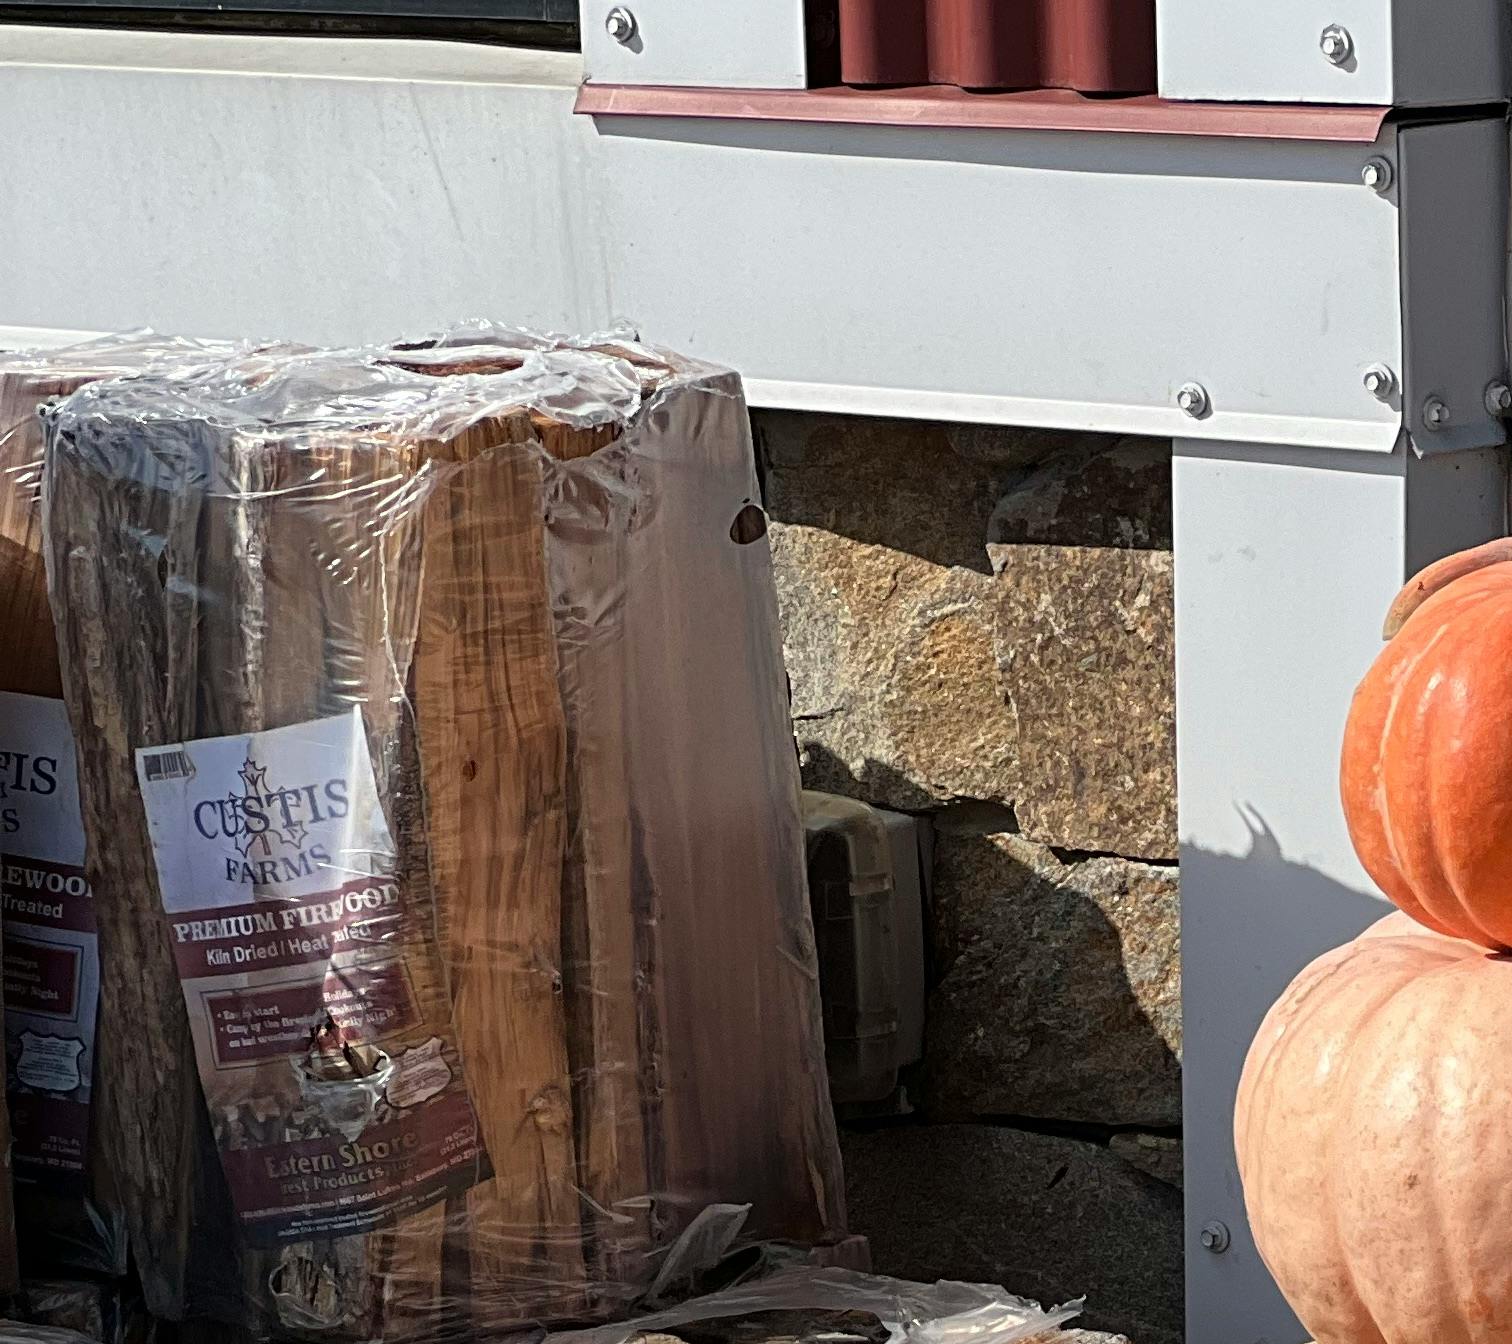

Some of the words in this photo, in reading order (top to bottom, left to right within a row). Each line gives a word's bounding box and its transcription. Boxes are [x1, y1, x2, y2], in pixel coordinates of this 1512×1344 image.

[193, 778, 350, 841] CUSTIS
[225, 844, 332, 886] FARMS
[173, 912, 276, 944] PREMIUM
[206, 948, 232, 967] Kiln
[235, 940, 280, 963] Dried
[289, 935, 330, 956] Heat
[338, 1131, 421, 1169] Shore
